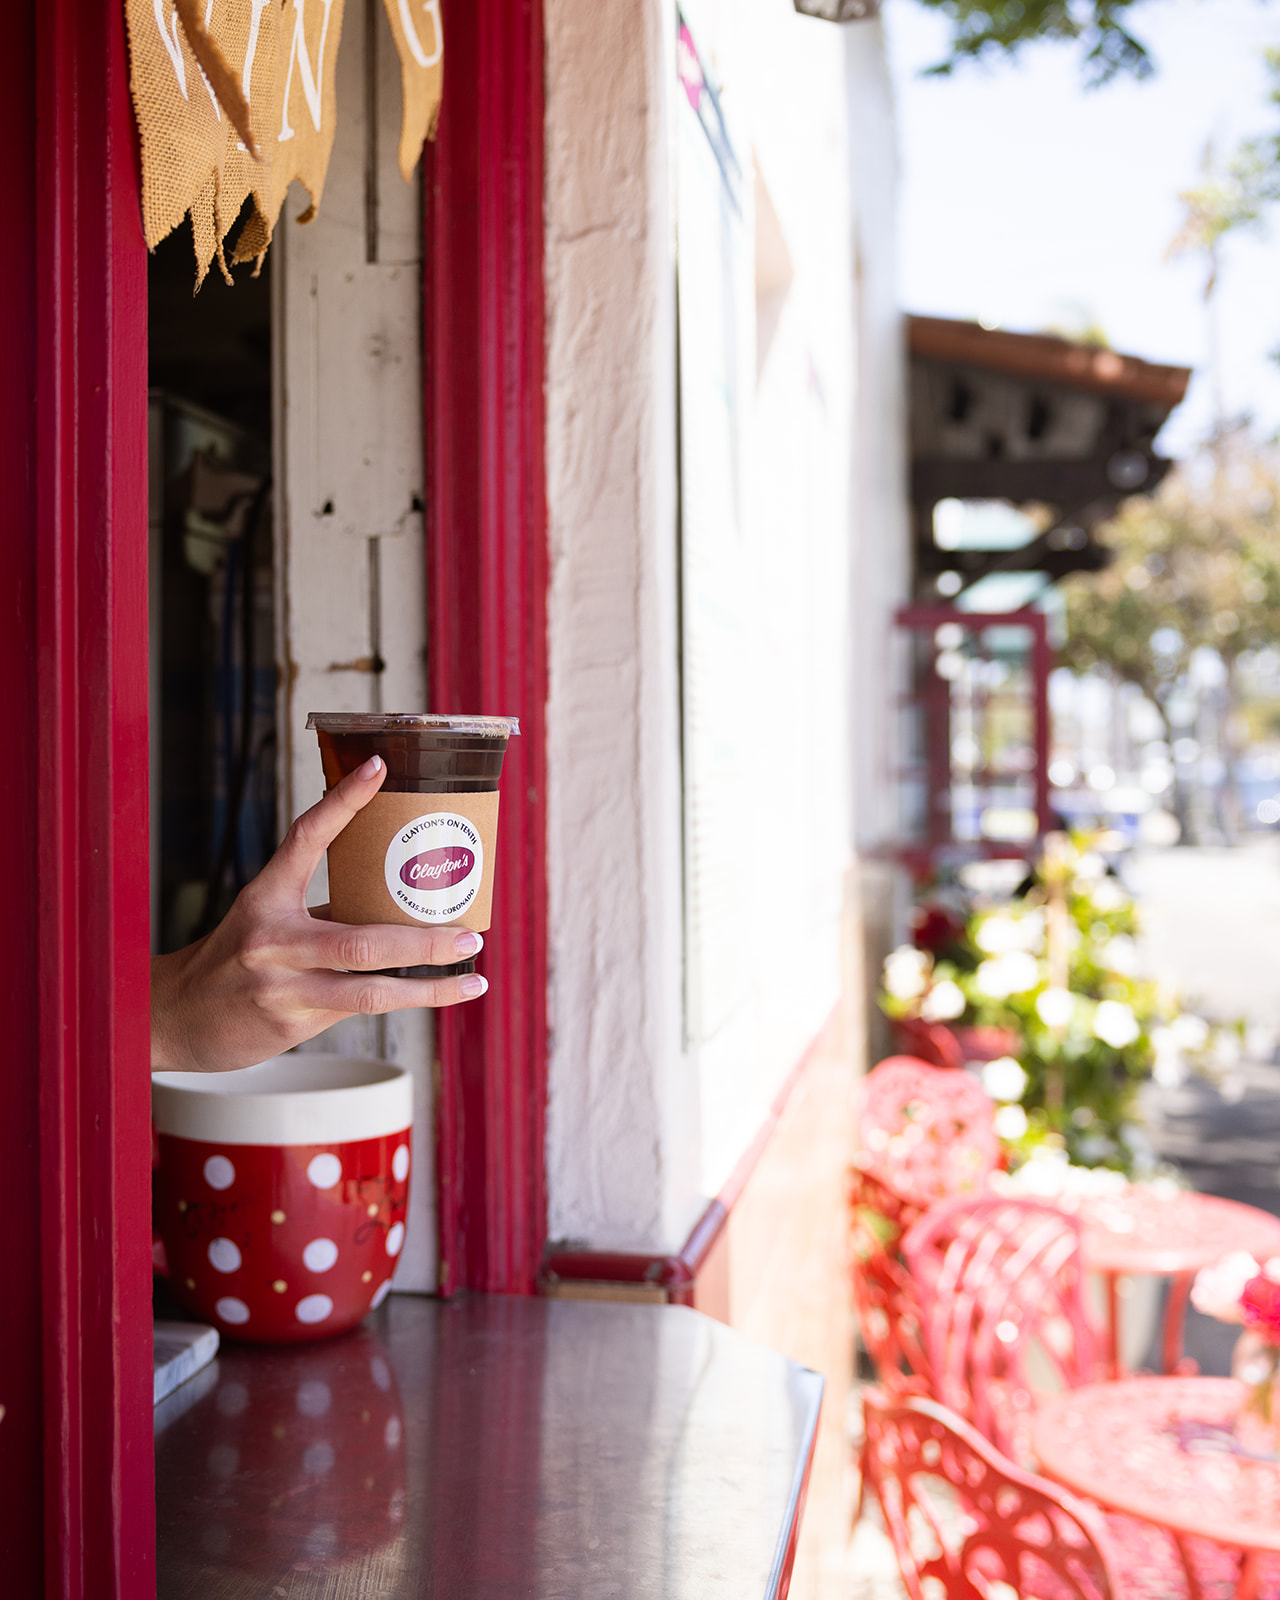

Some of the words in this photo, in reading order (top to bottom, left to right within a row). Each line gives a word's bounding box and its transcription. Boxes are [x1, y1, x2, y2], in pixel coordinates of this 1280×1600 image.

[401, 819, 445, 844] CLAYTON'S
[446, 819, 460, 828] ON
[460, 823, 478, 845] TENTH
[410, 854, 468, 880] Clayton's
[396, 890, 437, 915] 619.435.5425
[442, 888, 475, 915] CORONADO
